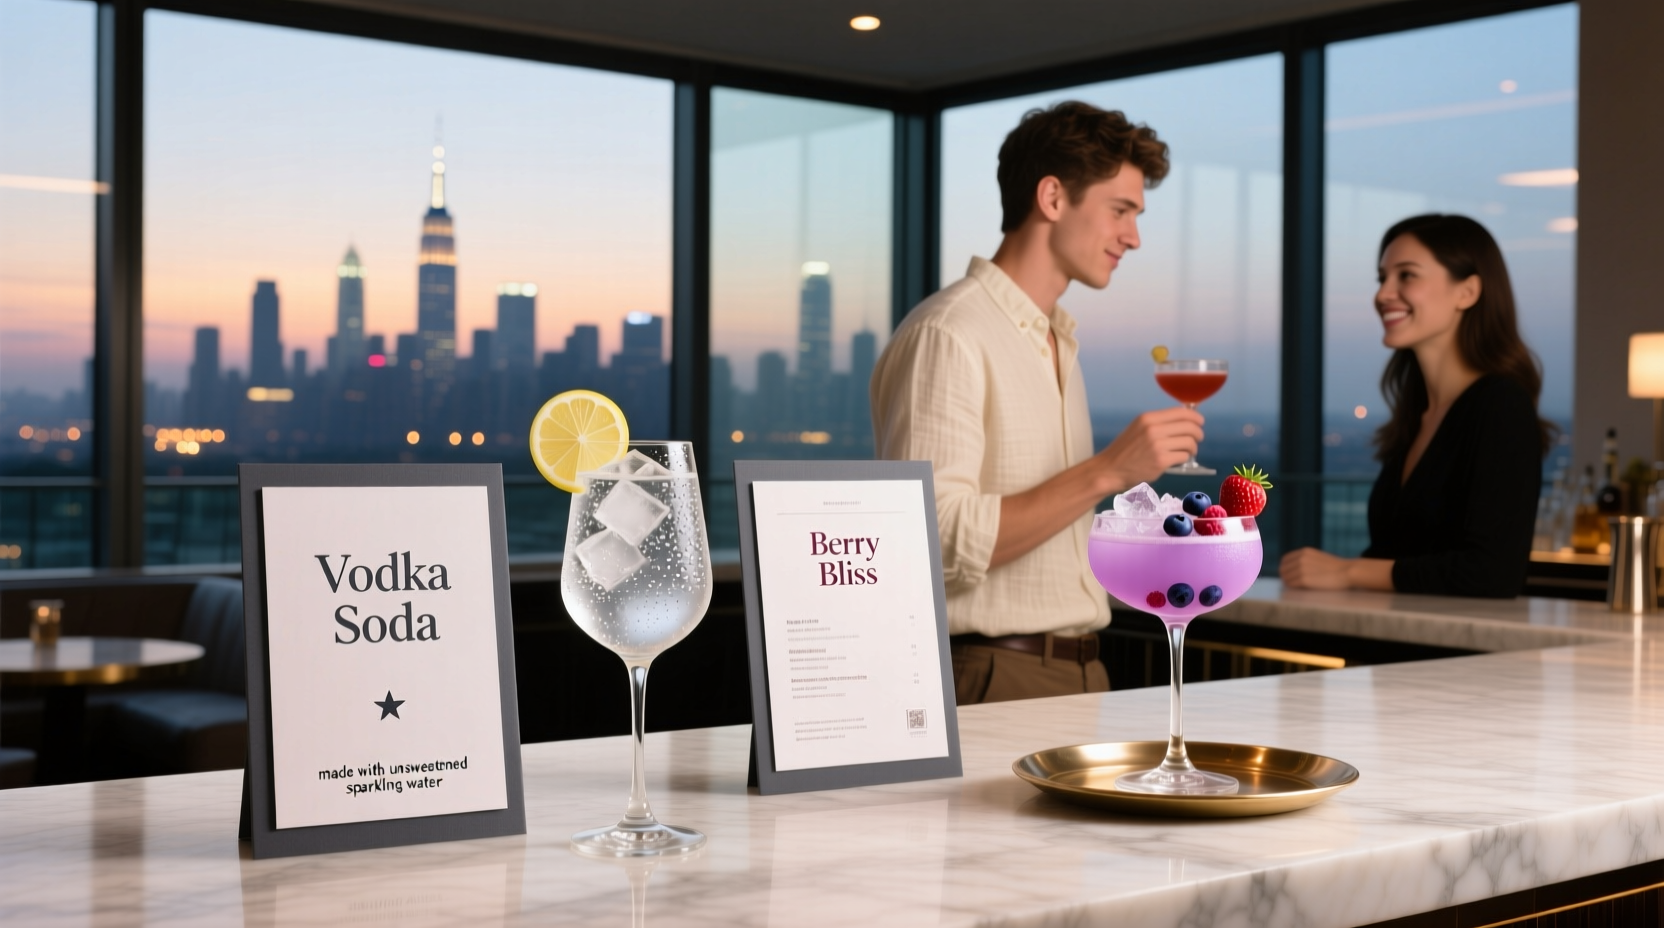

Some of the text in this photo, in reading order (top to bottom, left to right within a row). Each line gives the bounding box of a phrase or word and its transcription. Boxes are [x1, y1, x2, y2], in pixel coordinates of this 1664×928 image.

[809, 531, 880, 562] Berry
[314, 550, 452, 594] Vodka
[818, 560, 879, 587] Bliss
[334, 600, 441, 645] Soda
[318, 764, 354, 780] made
[357, 761, 386, 777] with
[405, 776, 444, 790] water
